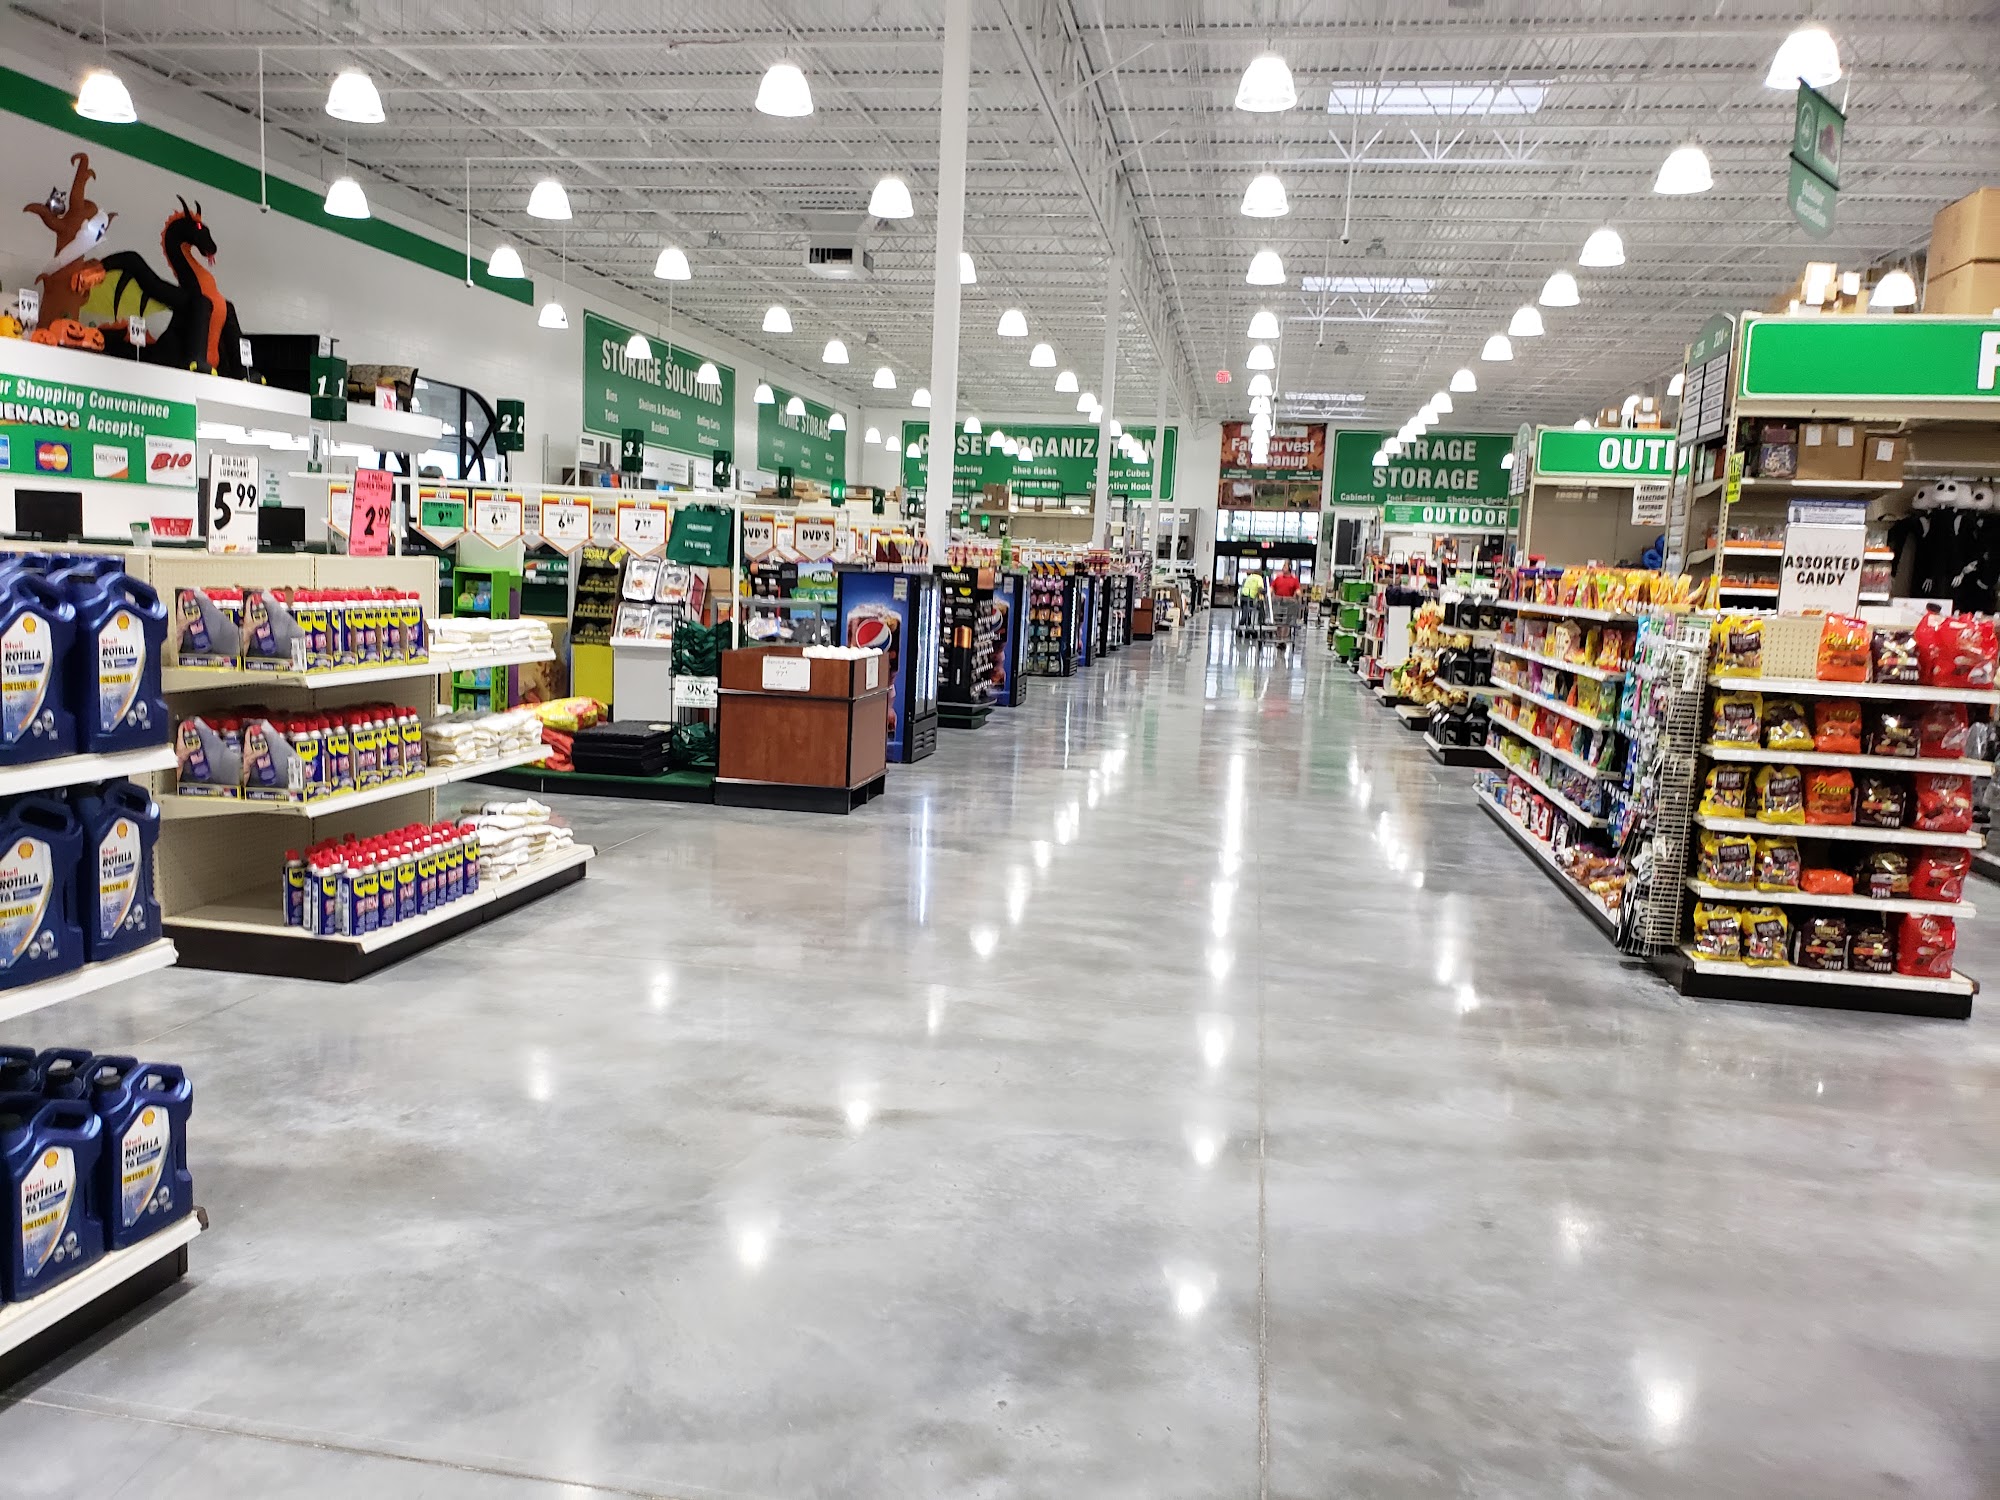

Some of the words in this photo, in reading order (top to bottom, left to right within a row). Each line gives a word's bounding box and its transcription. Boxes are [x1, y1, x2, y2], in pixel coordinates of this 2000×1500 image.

[602, 339, 661, 386] STORAGE
[317, 375, 327, 396] 1
[337, 377, 344, 398] 1
[17, 379, 84, 409] Shopping
[89, 391, 170, 419] Convenience
[0, 402, 80, 428] ENARDS
[500, 414, 512, 432] 2
[802, 412, 831, 441] STORAGE
[624, 441, 634, 456] 3
[919, 433, 991, 456] CSET
[1003, 434, 1155, 458] RGANIZTIN
[1269, 440, 1315, 453] arvest
[1237, 452, 1247, 466] &
[1599, 437, 1691, 471] OUTD
[220, 469, 250, 478] LUBRICANT
[715, 460, 724, 475] 4
[1013, 466, 1031, 475] Shoe
[1034, 466, 1057, 475] Racks
[1126, 468, 1150, 478] Cubes
[1372, 467, 1479, 490] STORAGE
[1341, 493, 1375, 502] Cabinets
[1422, 506, 1508, 525] OUTDOOR
[802, 529, 830, 542] DVD'S
[1785, 555, 1860, 571] ASSORTED
[941, 571, 969, 582] DURACELL
[1796, 572, 1846, 586] CANDY
[5, 651, 41, 661] ROTELLA
[102, 646, 134, 656] ROTELLA
[102, 851, 132, 867] ROTELLA
[0, 873, 39, 889] ROTELLA
[125, 1139, 159, 1158] ROTELLA
[25, 1180, 63, 1203] ROTELLA
